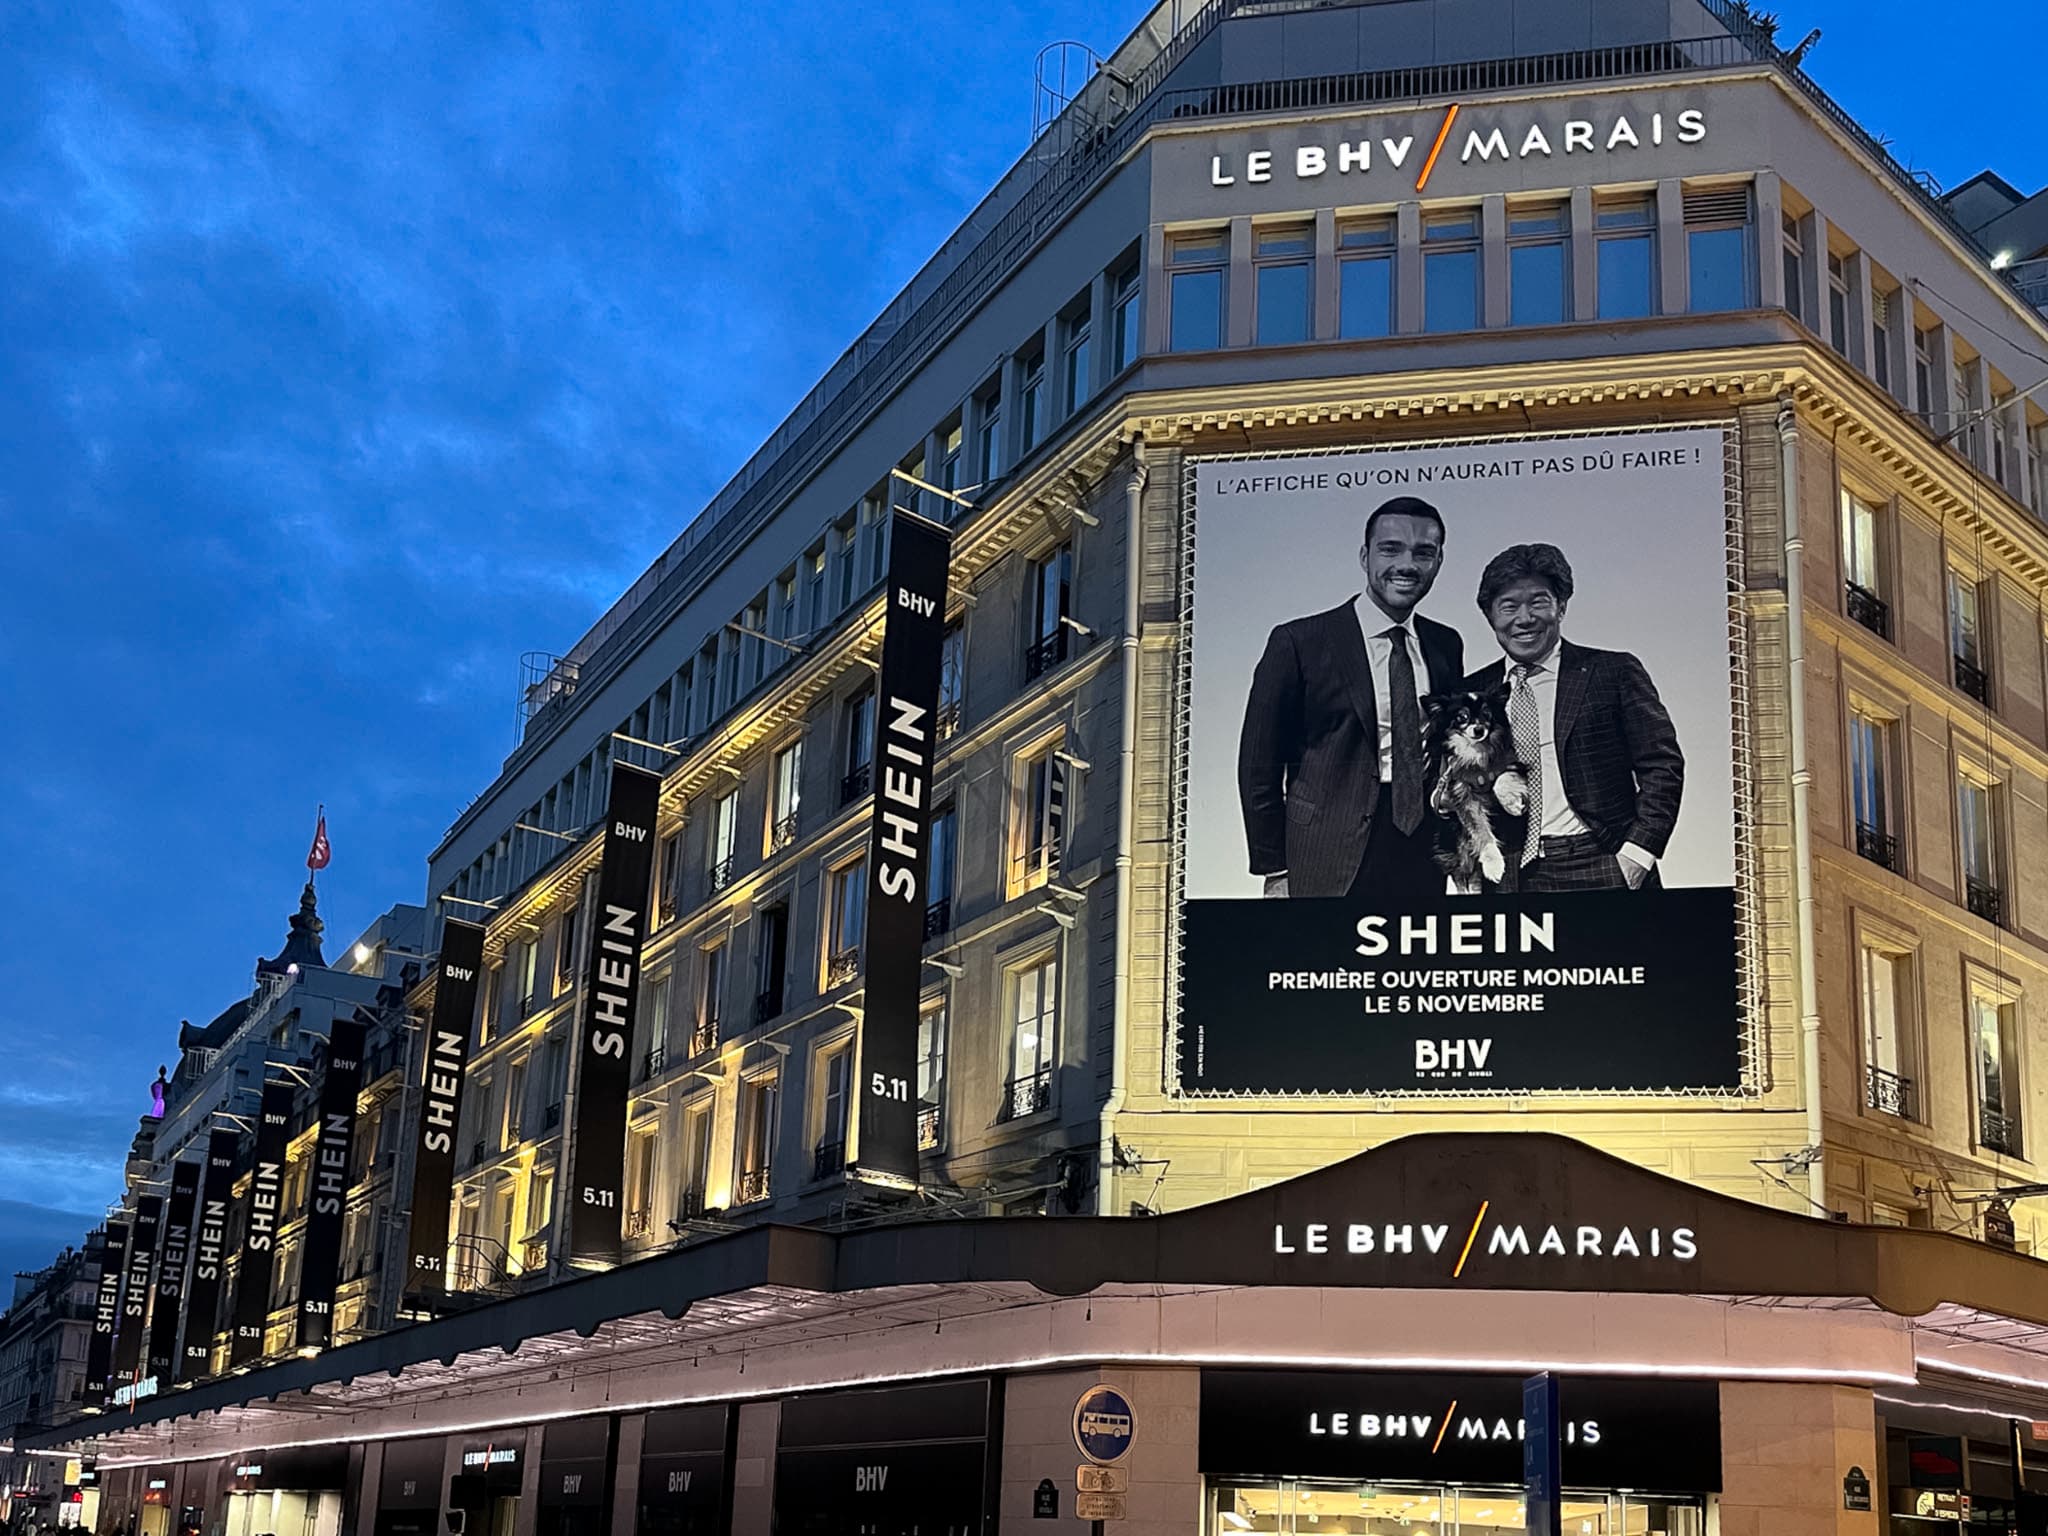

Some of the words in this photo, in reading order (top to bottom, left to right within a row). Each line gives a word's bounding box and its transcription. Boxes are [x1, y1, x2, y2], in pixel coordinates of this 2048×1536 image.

[1212, 151, 1272, 185] LE
[1217, 473, 1329, 495] L'AFFICHE
[1336, 468, 1409, 489] QU'ON
[1417, 460, 1525, 483] N'AURAIT
[1532, 457, 1575, 475] PAS
[1583, 450, 1614, 471] DÛ
[1622, 449, 1686, 469] FAIRE
[1695, 448, 1701, 464] !
[899, 587, 936, 618] BHV
[880, 696, 927, 903] SHEIN
[616, 821, 647, 842] BHV
[1355, 912, 1555, 956] SHEIN
[446, 964, 473, 981] BHV
[592, 904, 640, 1059] SHEIN
[1269, 967, 1376, 990] PREMIÈRE
[1382, 969, 1517, 989] OUVERTURE
[1523, 966, 1645, 987] MONDIALE
[1365, 996, 1391, 1014] LE
[1397, 996, 1411, 1013] 5
[1418, 993, 1545, 1013] NOVEMBRE
[334, 1058, 357, 1071] BHV
[1415, 1038, 1492, 1070] BHV
[424, 1031, 463, 1153] SHEIN
[871, 1072, 907, 1102] 5.11
[265, 1113, 287, 1125] BHV
[212, 1157, 232, 1167] BHV
[315, 1113, 351, 1215] SHEIN
[249, 1161, 283, 1252] SHEIN
[583, 1187, 614, 1208] 5.11
[198, 1200, 227, 1280] SHEIN
[1275, 1224, 1328, 1254] LE
[160, 1224, 188, 1297] SHEIN
[125, 1250, 150, 1317] SHEIN
[96, 1272, 118, 1333] SHEIN
[305, 1300, 328, 1314] 5.11
[239, 1326, 260, 1338] 5.11
[187, 1346, 207, 1358] 5.11
[1310, 1412, 1349, 1436] LE
[1457, 1417, 1601, 1444] MAIS
[563, 1474, 582, 1494] BHV
[668, 1471, 692, 1493] BHV
[856, 1465, 889, 1492] BHV
